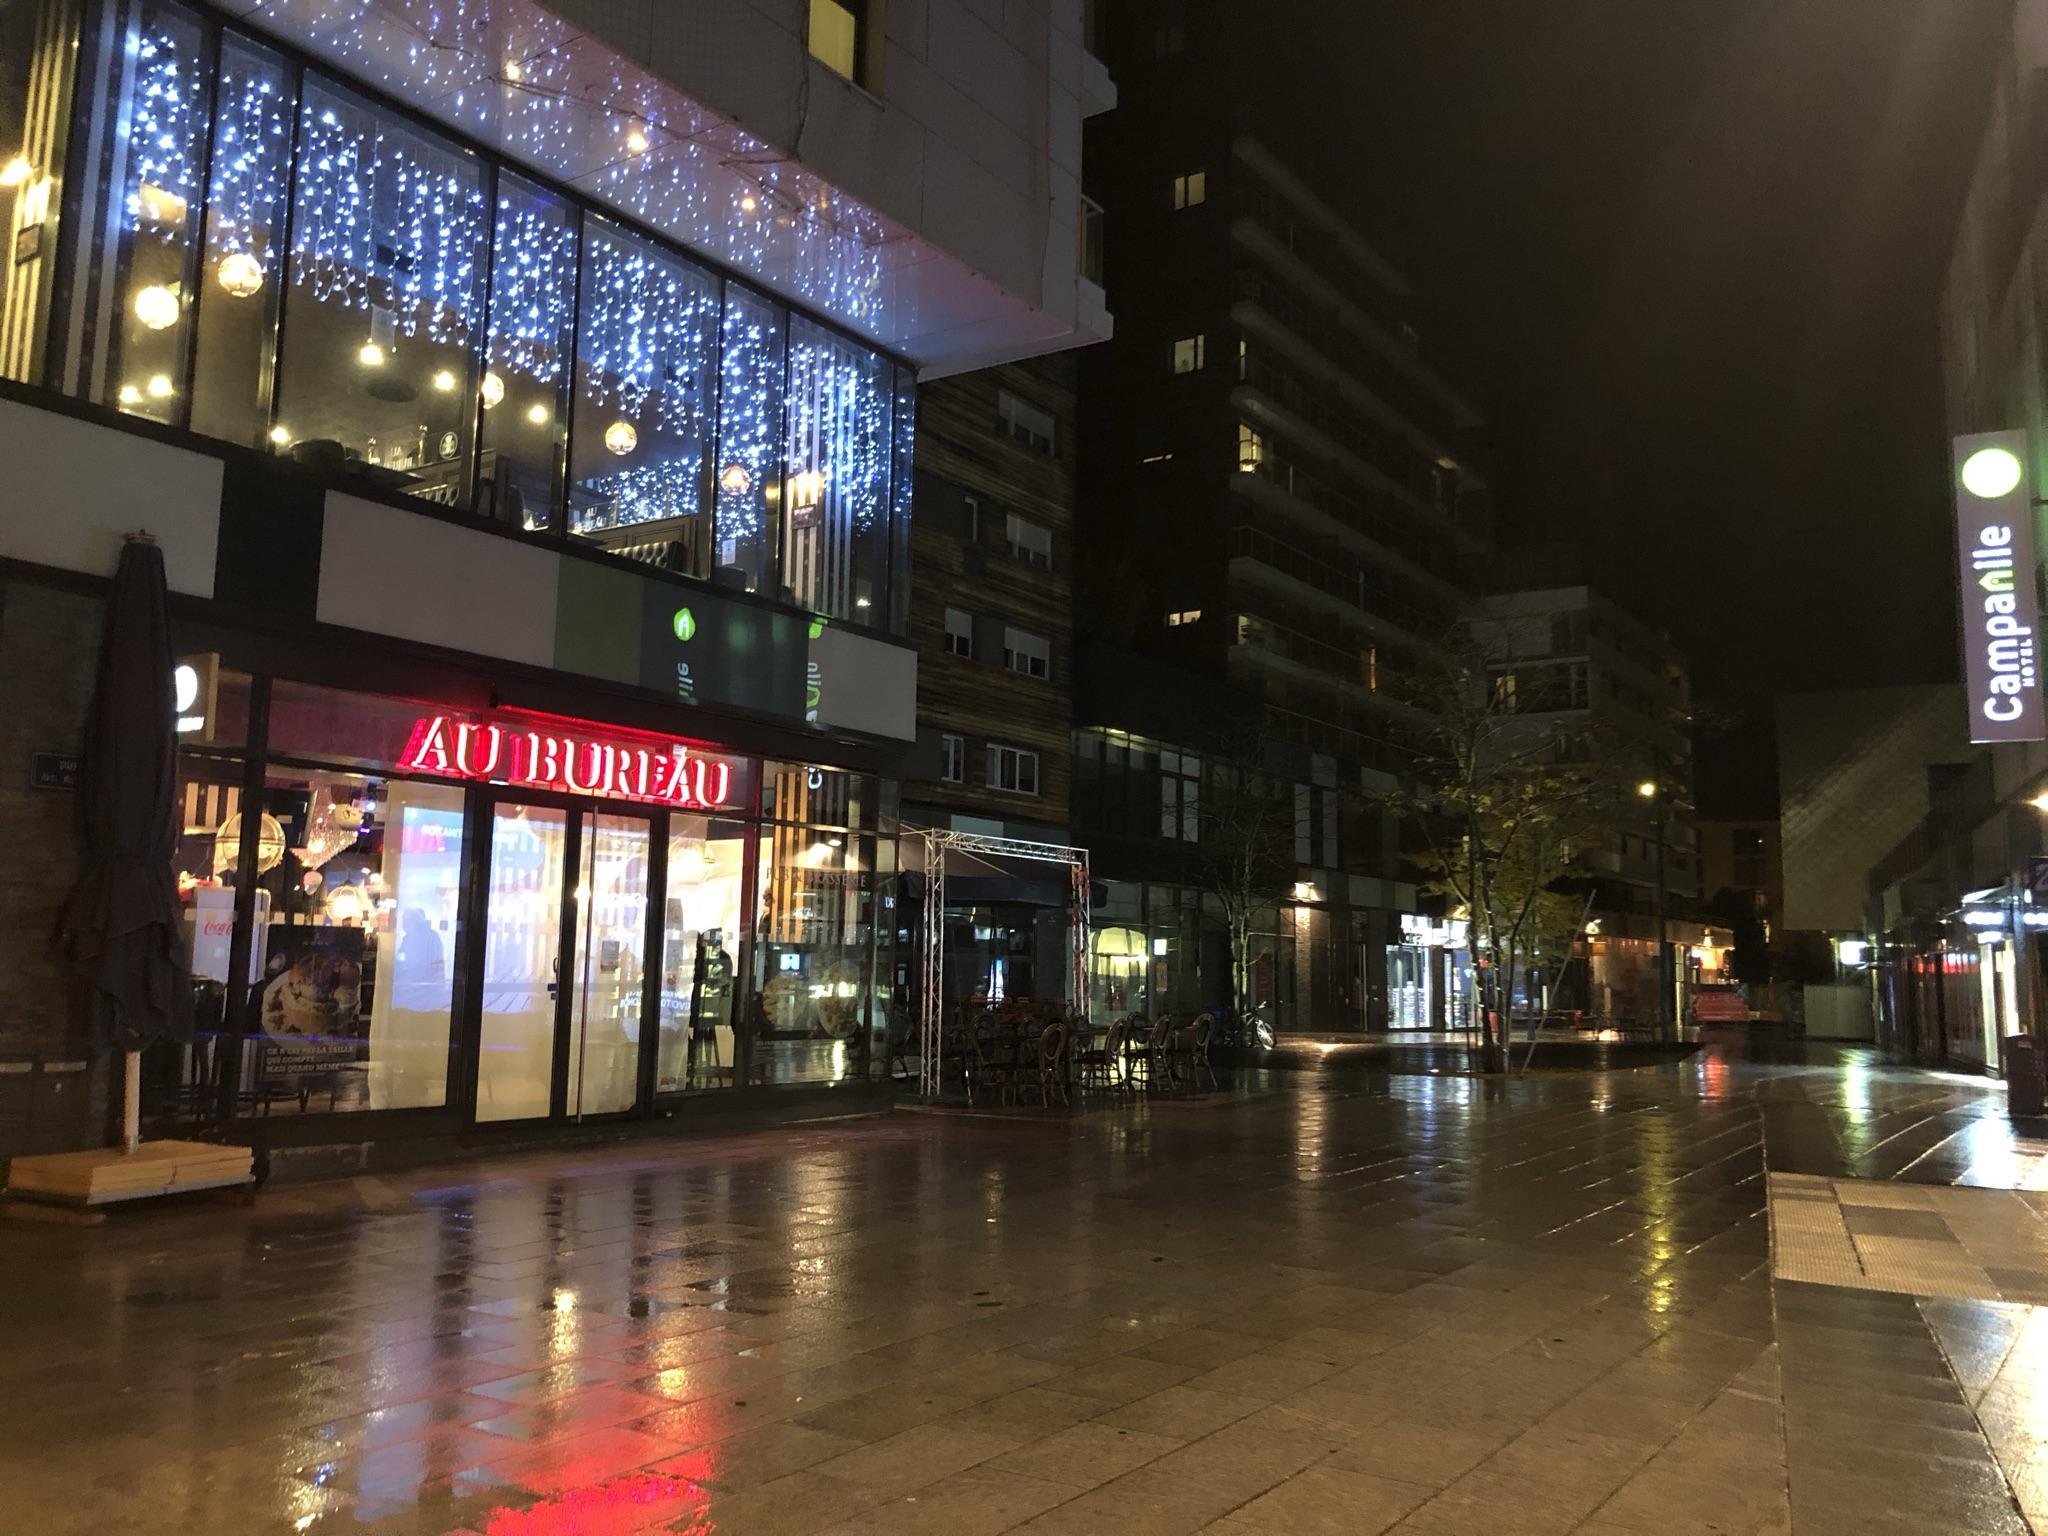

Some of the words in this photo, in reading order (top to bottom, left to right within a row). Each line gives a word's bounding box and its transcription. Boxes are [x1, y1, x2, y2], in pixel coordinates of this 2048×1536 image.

[1971, 525, 2032, 722] Campanile
[2020, 638, 2035, 687] HOTEL
[411, 715, 503, 777] AU
[525, 732, 731, 807] BUREAU
